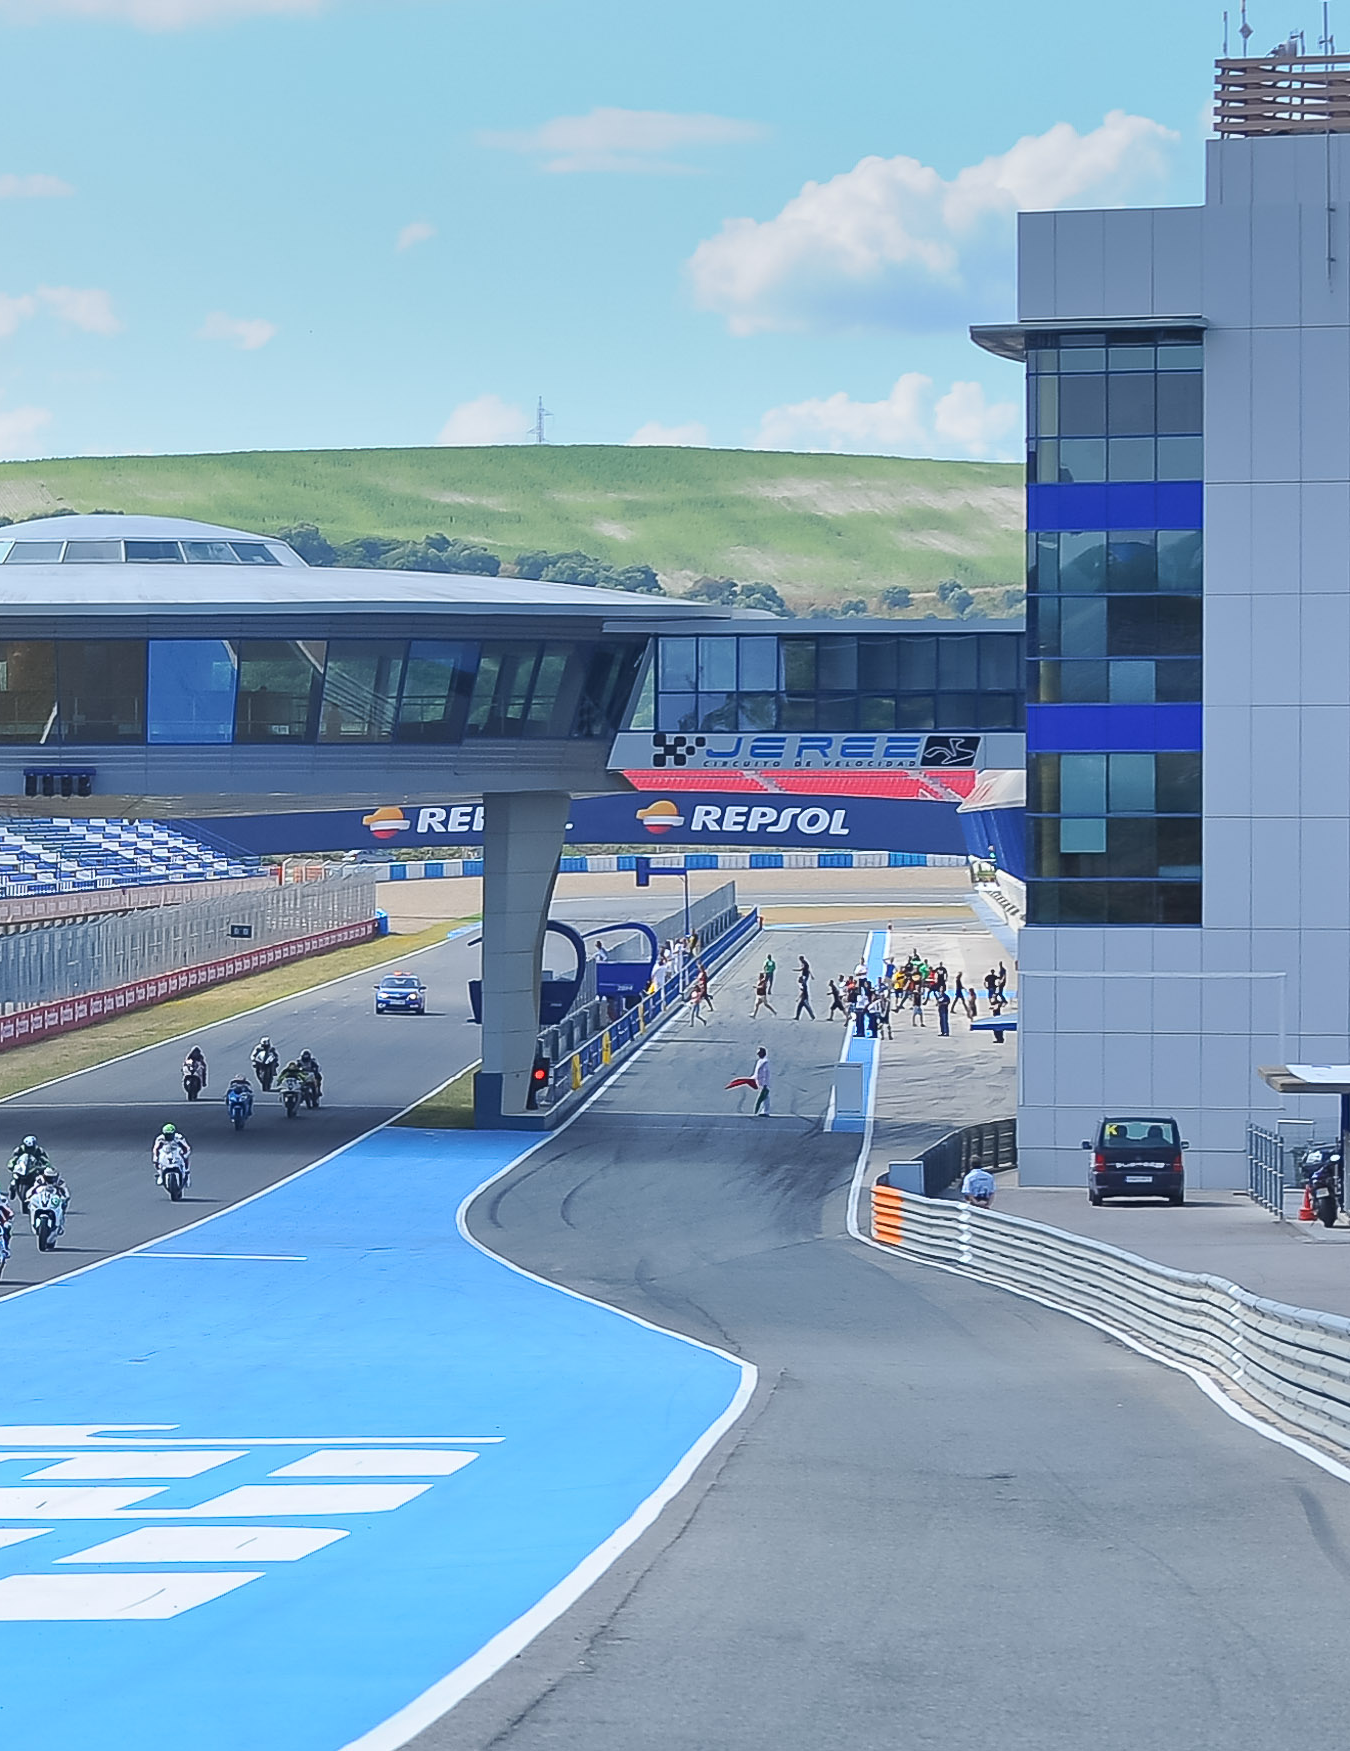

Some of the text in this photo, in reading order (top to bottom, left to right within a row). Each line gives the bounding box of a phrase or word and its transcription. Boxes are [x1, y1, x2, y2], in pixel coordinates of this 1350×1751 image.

[702, 760, 917, 768] CIRCUITO DE VELOCIDAD
[691, 805, 850, 835] REPSOL
